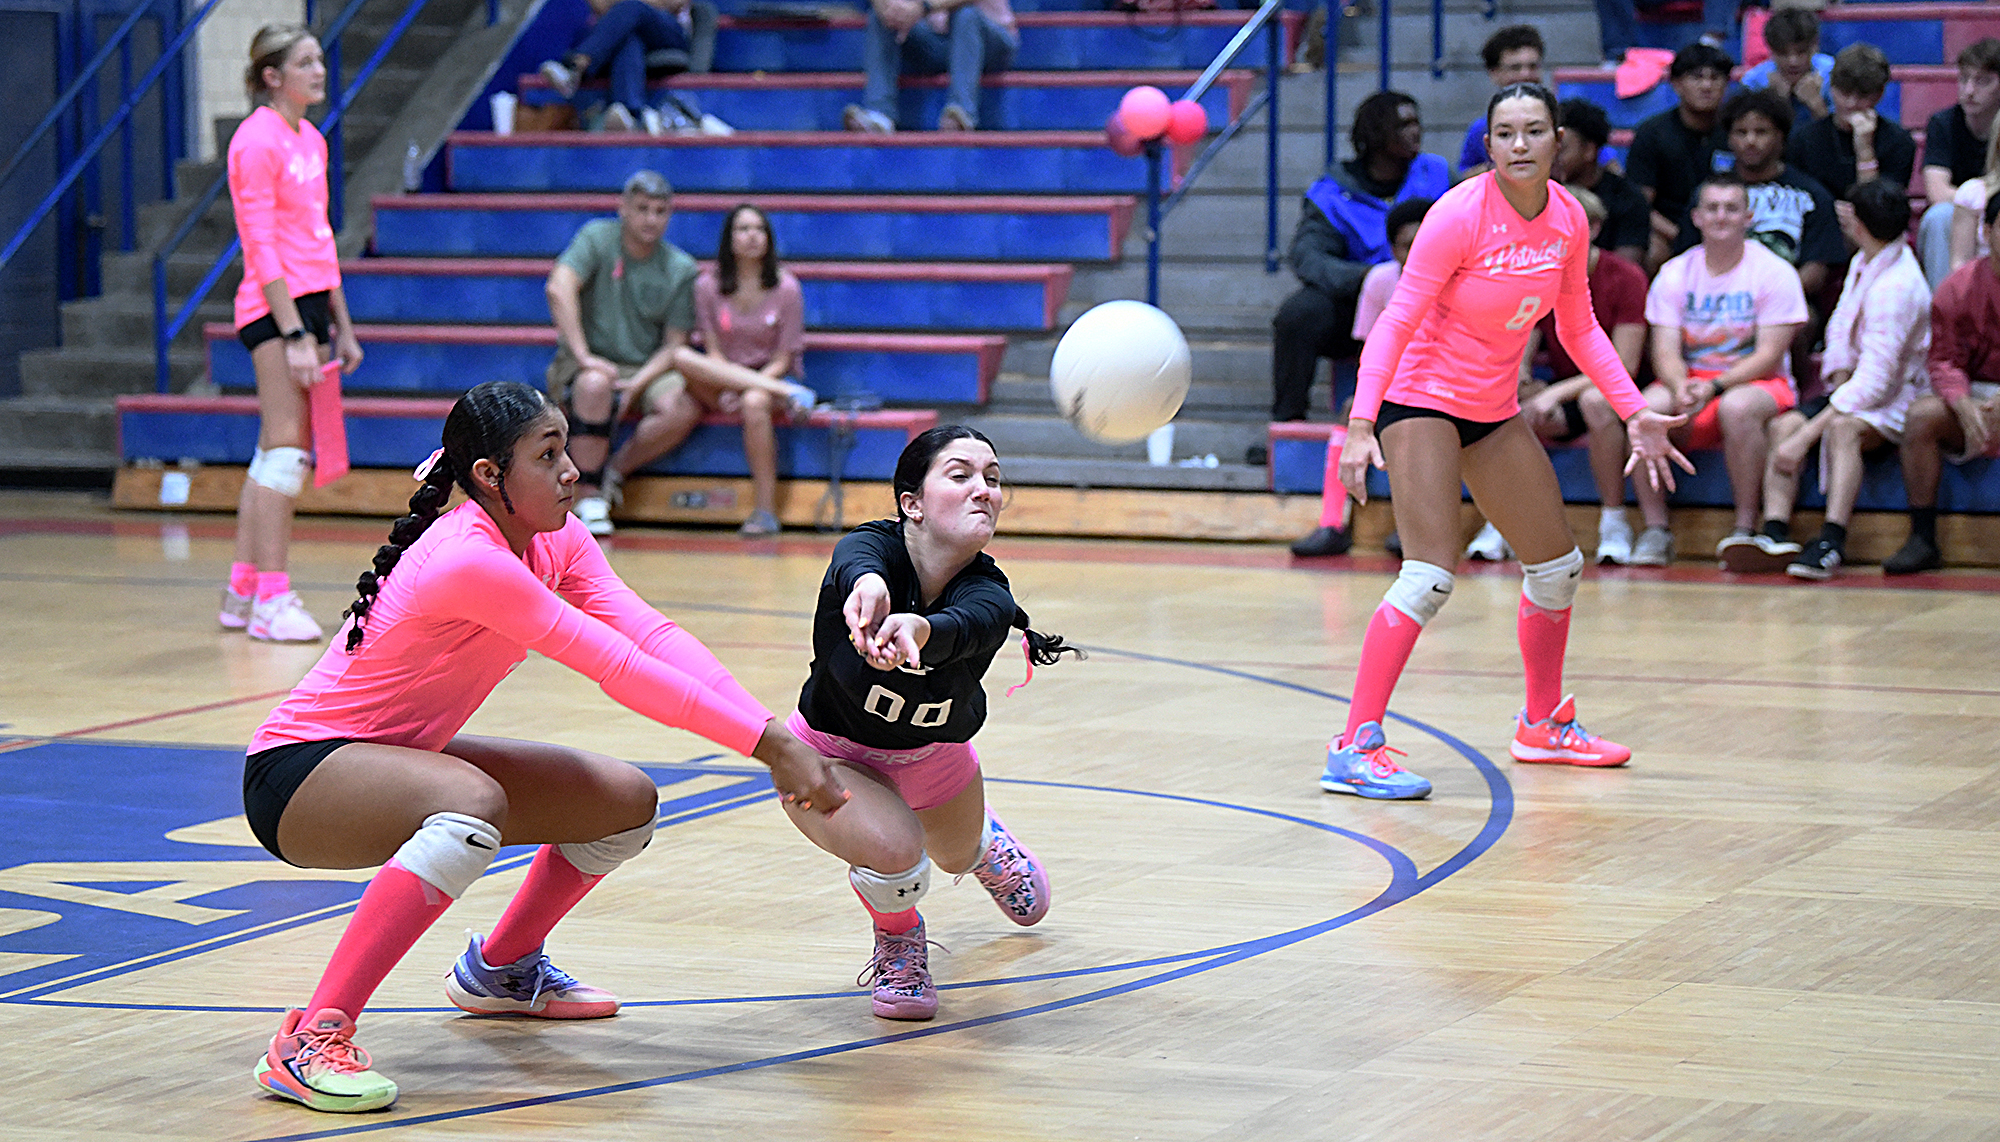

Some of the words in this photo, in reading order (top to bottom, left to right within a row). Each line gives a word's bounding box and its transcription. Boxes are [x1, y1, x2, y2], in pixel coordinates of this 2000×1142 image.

[1505, 296, 1541, 330] 8
[863, 684, 953, 728] 00
[862, 746, 936, 765] PRO
